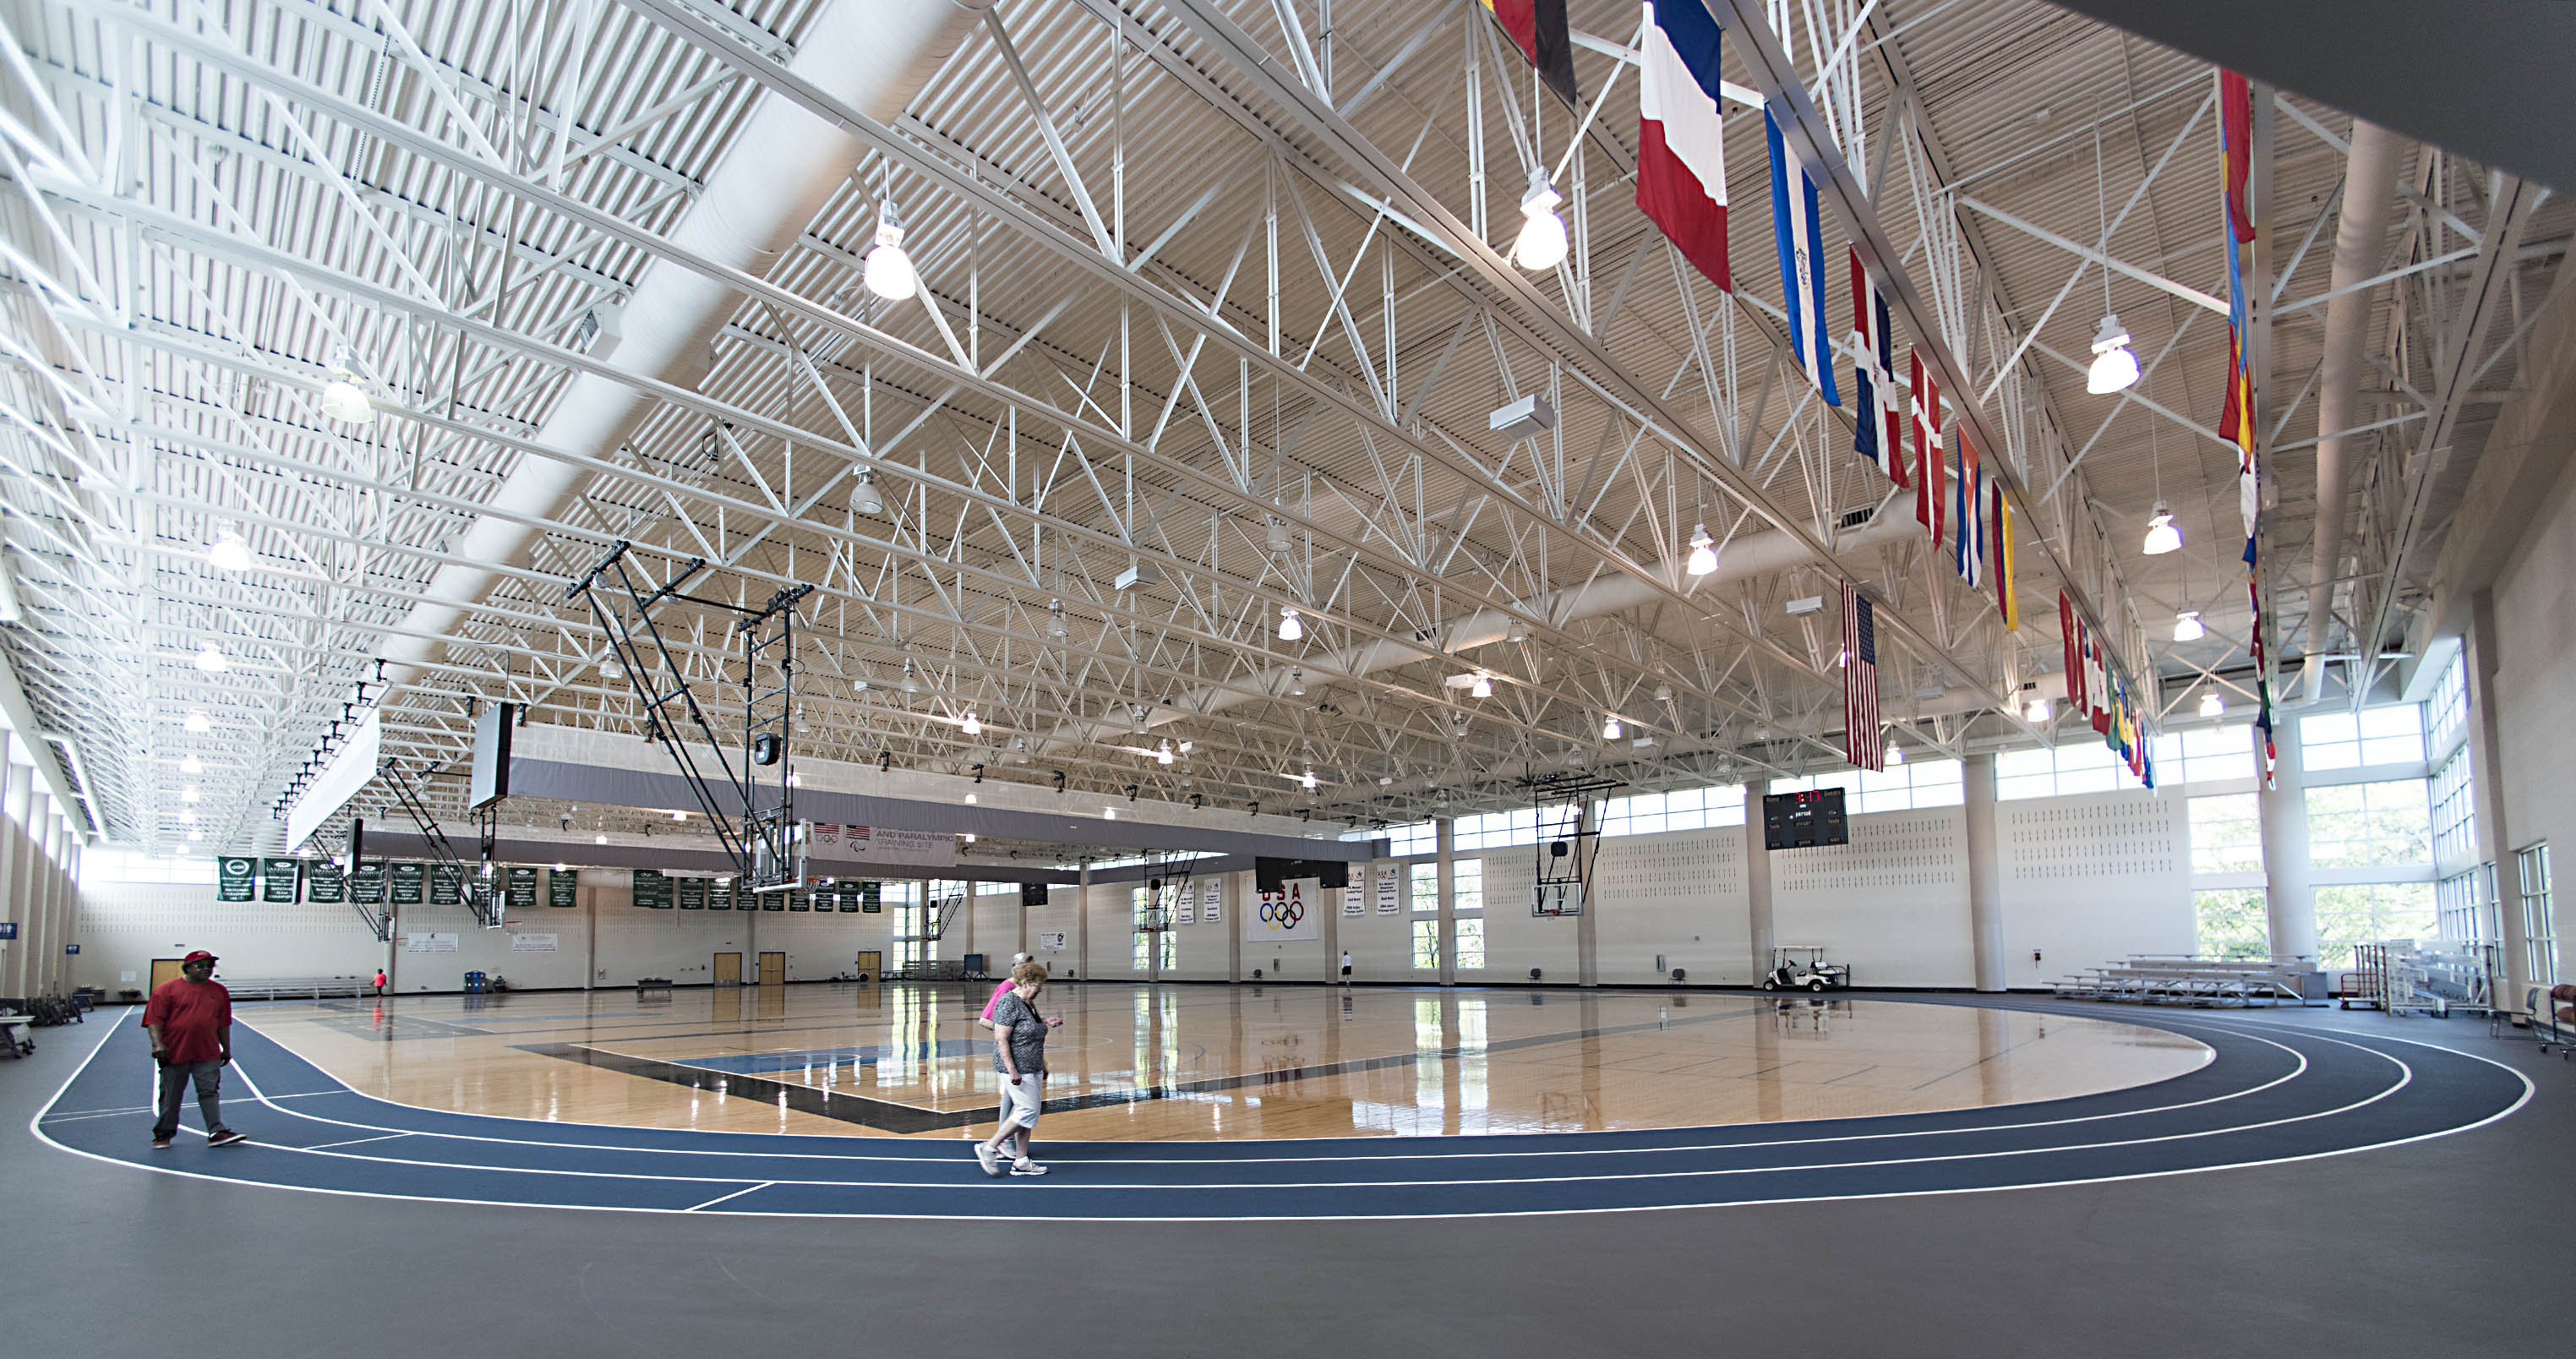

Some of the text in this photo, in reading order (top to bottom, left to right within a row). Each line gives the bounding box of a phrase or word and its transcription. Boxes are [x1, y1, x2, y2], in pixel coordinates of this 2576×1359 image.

[876, 831, 896, 839] AND
[899, 832, 954, 843] PARALYMPIC
[877, 839, 914, 848] TRAINING
